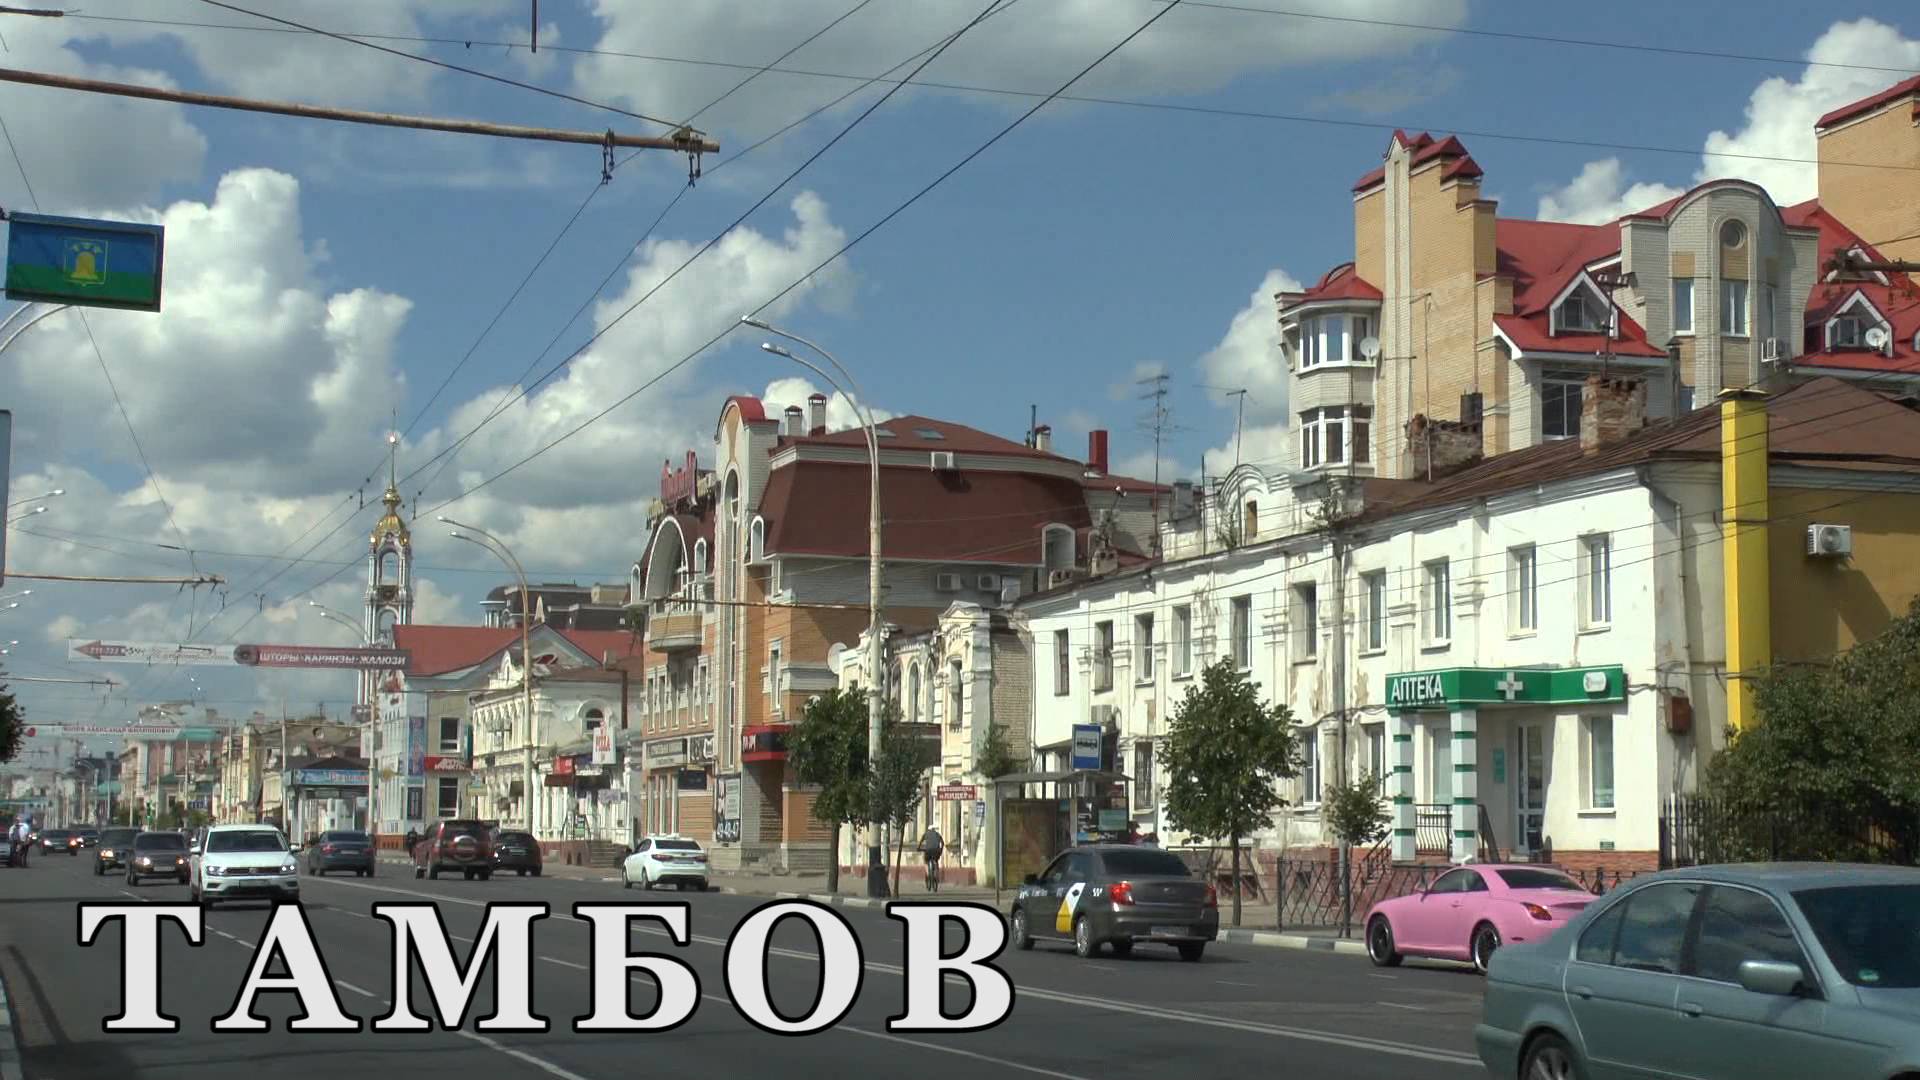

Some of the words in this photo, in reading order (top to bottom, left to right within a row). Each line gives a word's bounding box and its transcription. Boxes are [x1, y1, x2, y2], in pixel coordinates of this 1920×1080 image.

[259, 652, 299, 663] ШТОРЫ
[360, 655, 406, 666] ЖАЛЮЗИ
[1391, 674, 1444, 702] АПТЕКА
